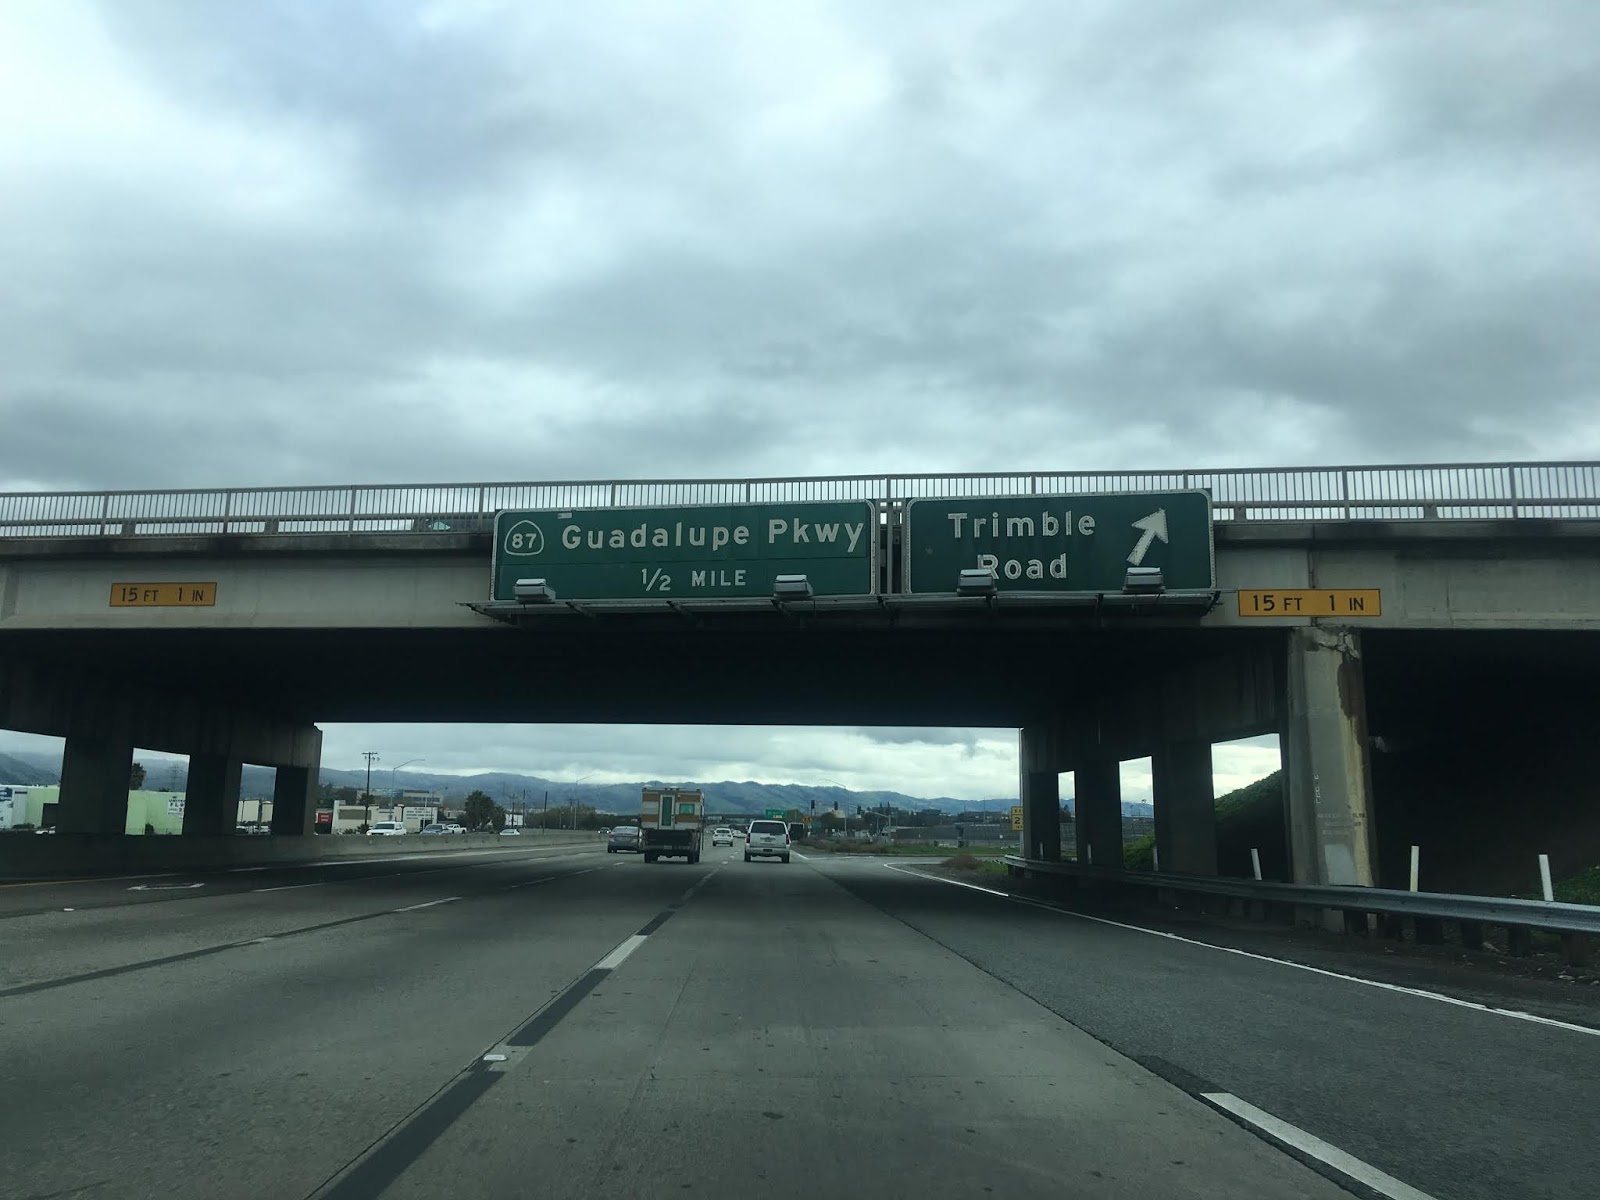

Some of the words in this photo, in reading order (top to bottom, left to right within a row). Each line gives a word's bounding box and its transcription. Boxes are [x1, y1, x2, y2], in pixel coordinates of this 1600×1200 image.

[947, 510, 1096, 539] Trimble
[512, 533, 537, 549] 87
[562, 521, 750, 551] Guadalupe
[768, 518, 864, 553] Pkwy
[976, 553, 1067, 581] Road
[691, 570, 747, 587] MILE
[121, 587, 138, 602] 15
[143, 589, 159, 602] FT
[178, 587, 183, 602] 1
[192, 589, 204, 602] IN
[1252, 594, 1275, 611] 15
[1283, 597, 1302, 611] FT
[1329, 594, 1335, 611] 1
[1349, 597, 1364, 611] IN
